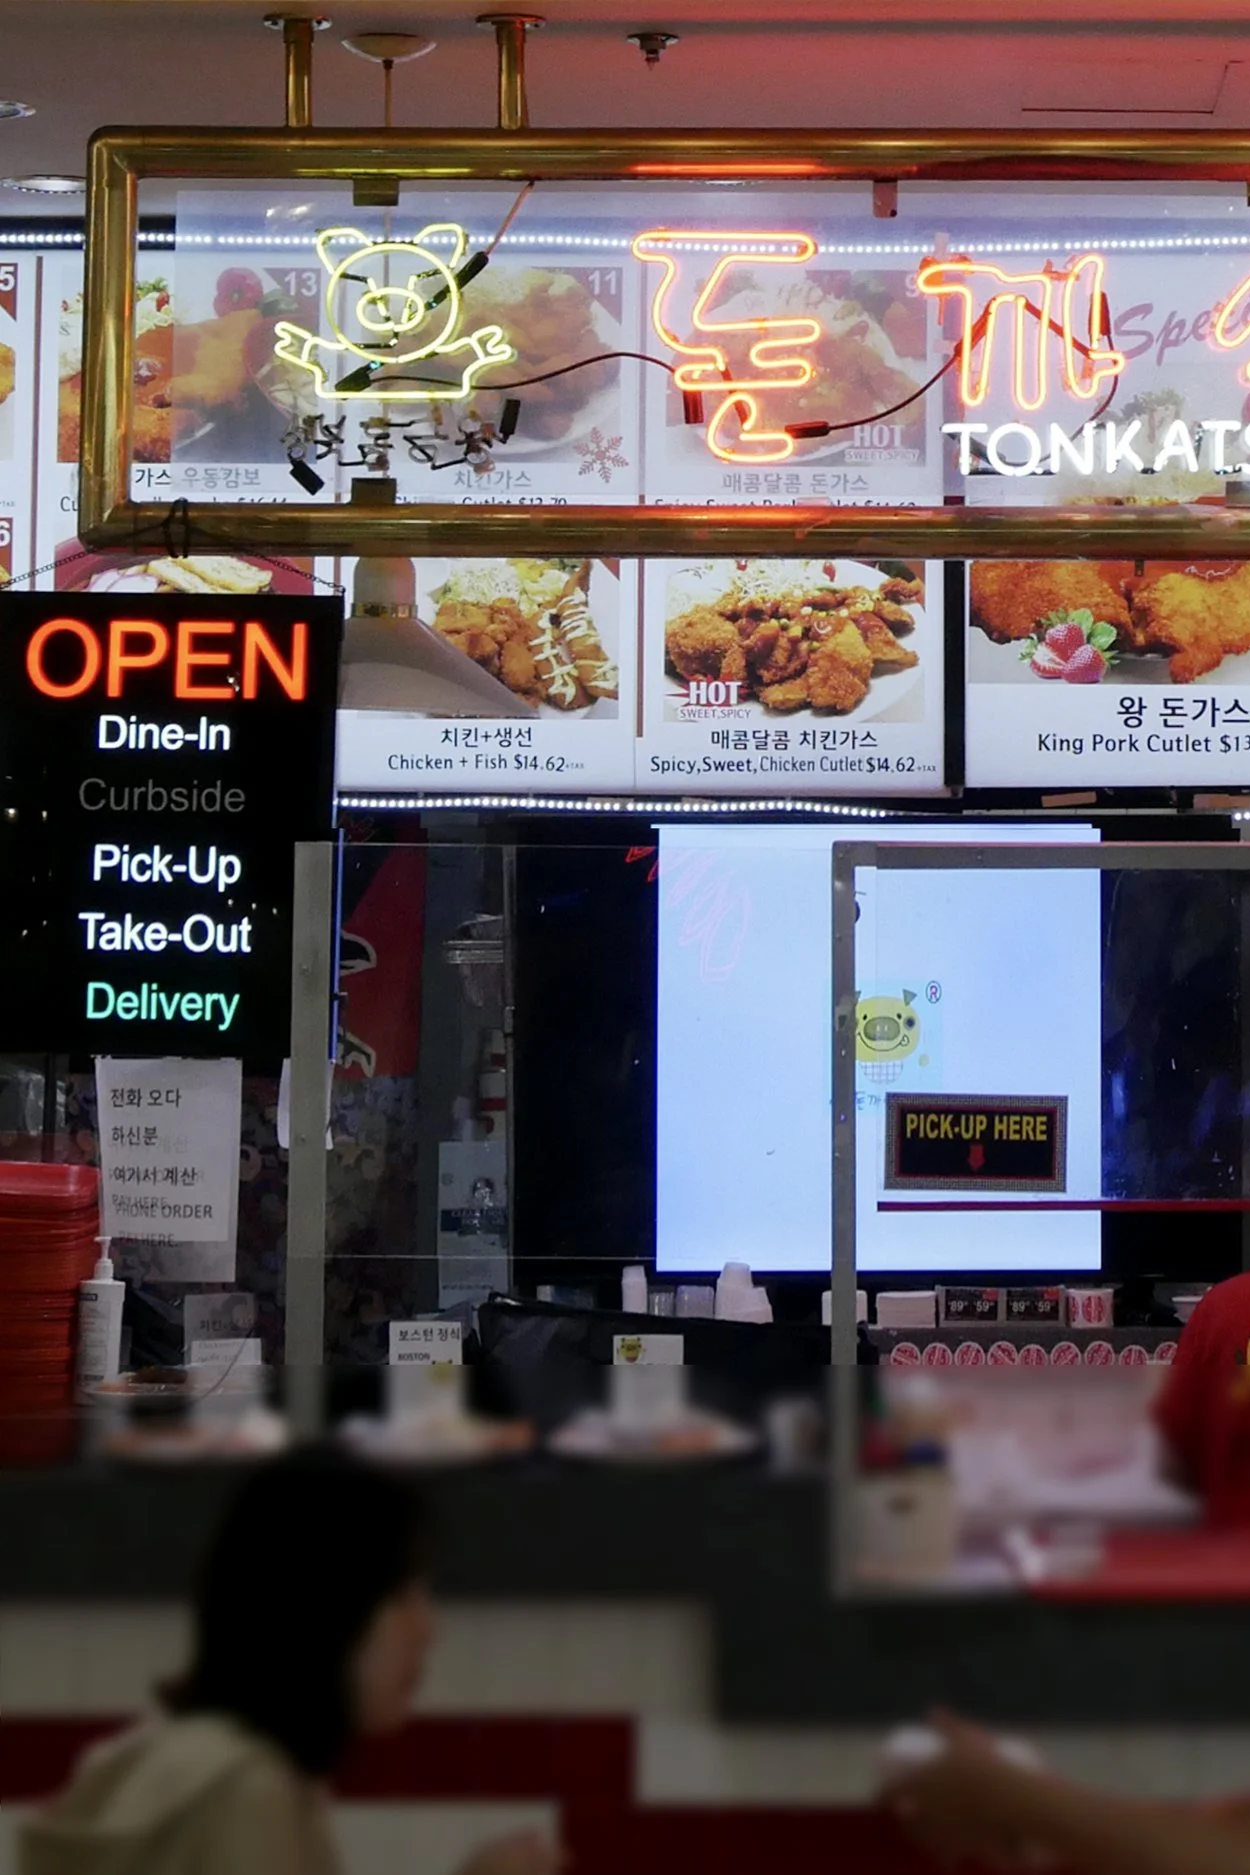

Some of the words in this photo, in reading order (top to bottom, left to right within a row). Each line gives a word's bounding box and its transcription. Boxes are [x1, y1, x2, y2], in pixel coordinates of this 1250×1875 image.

[282, 271, 318, 297] 13
[587, 270, 618, 295] 11
[853, 424, 905, 448] HOT
[809, 473, 869, 493] 돈가스
[26, 617, 308, 701] OPEN
[689, 681, 742, 705] HOT
[1117, 696, 1147, 728] 왕
[1159, 696, 1250, 728] 돈가스
[98, 714, 231, 750] Dine-In
[440, 727, 533, 748] 치킨+생선
[710, 730, 791, 751] 매콤달콤
[799, 730, 878, 750] 치킨가스
[1037, 733, 1084, 754] King
[1092, 733, 1140, 752] Pork
[1147, 733, 1211, 753] Cutlet
[387, 754, 453, 770] Chicken
[474, 754, 508, 770] Fish
[79, 778, 246, 812] Curbside
[93, 844, 241, 892] Pick-Up
[78, 912, 252, 953] Take-Out
[86, 982, 240, 1031] Delivery
[110, 1087, 142, 1108] 전화
[111, 1126, 158, 1146] 하신분
[905, 1112, 987, 1139] PICK-UP
[993, 1115, 1048, 1141] HERE
[111, 1167, 157, 1186] 여기서
[162, 1166, 198, 1186] 계산
[161, 1204, 213, 1219] ORDER
